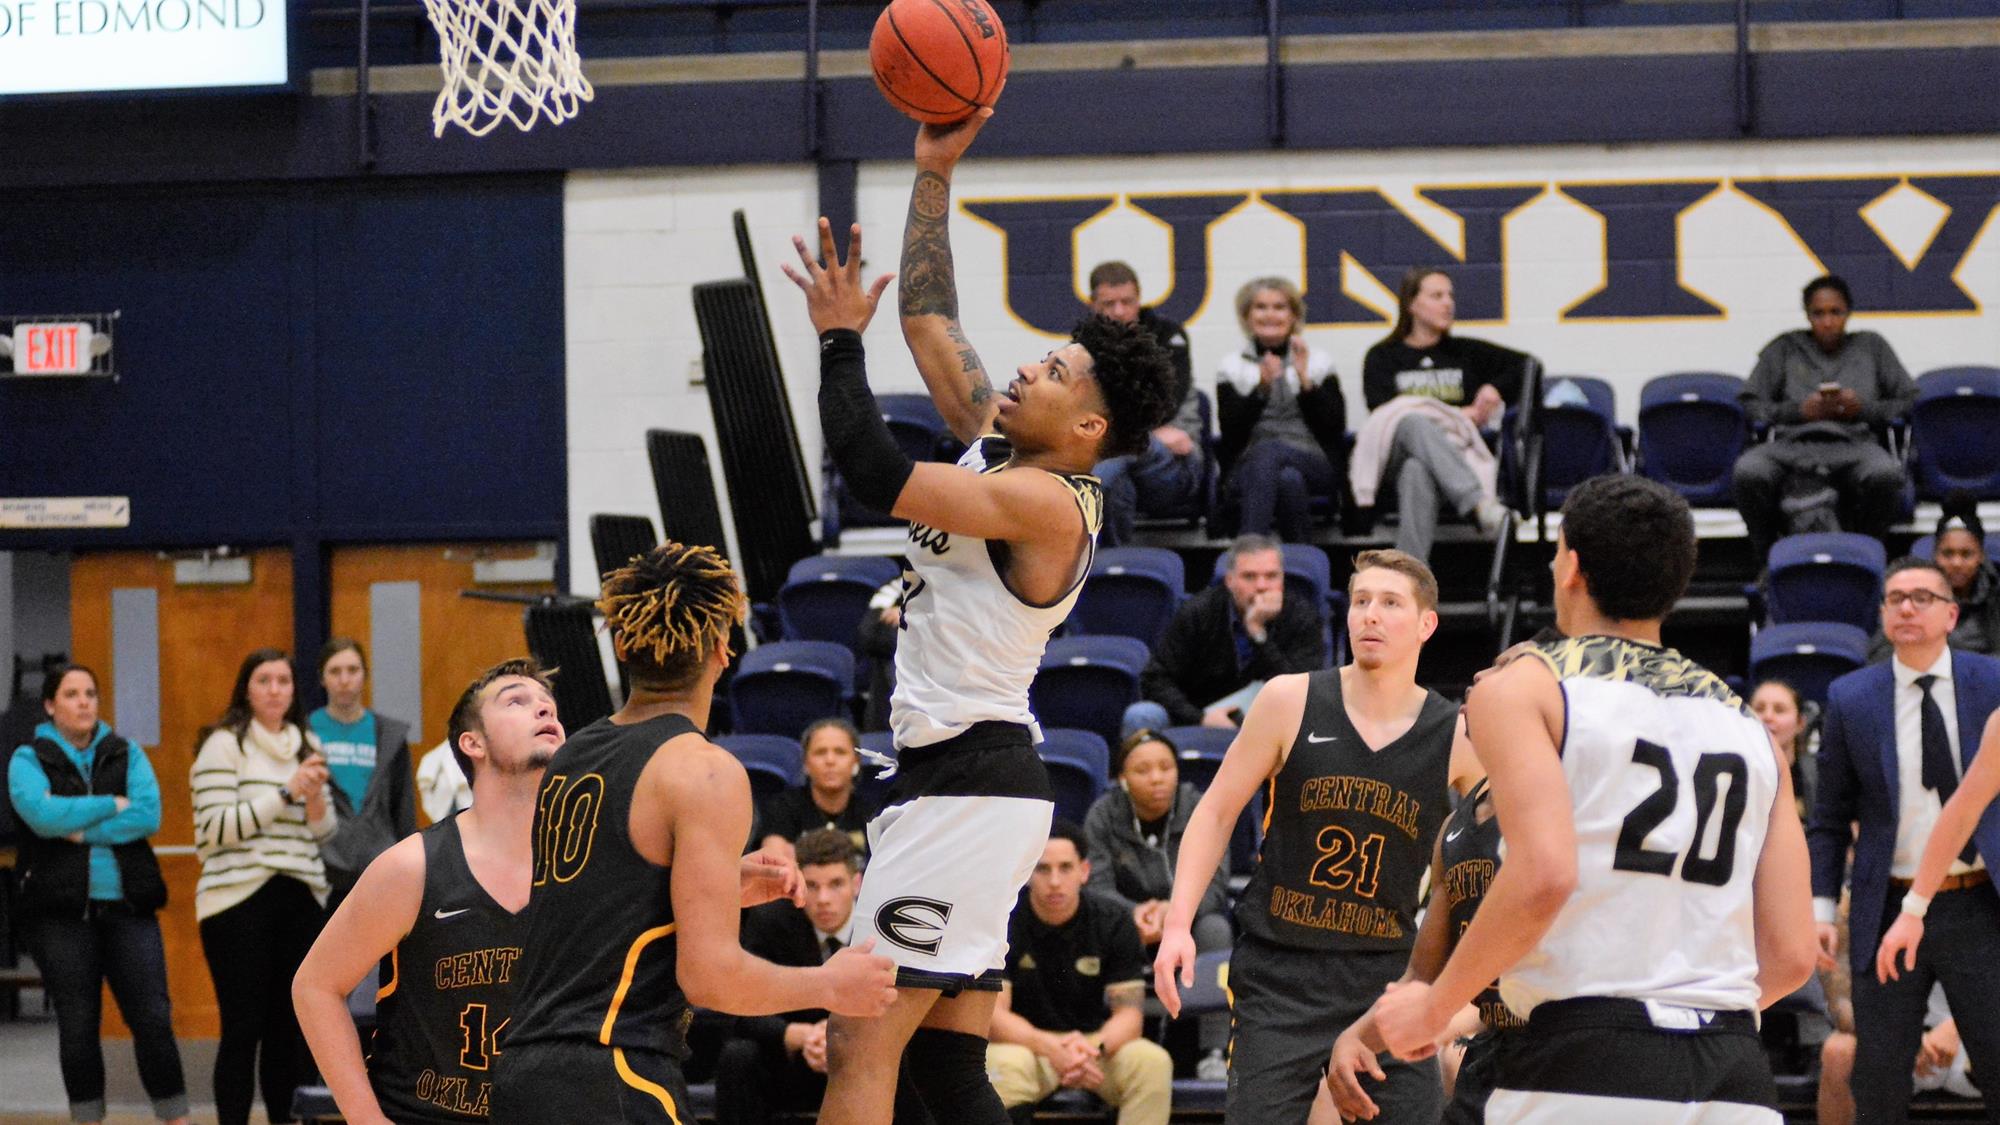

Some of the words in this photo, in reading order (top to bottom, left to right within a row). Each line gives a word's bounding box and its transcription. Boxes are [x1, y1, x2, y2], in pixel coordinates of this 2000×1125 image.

[55, 0, 265, 36] EDMOND
[957, 171, 2000, 341] UNIV
[27, 326, 78, 369] EXIT
[533, 773, 604, 886] 10
[1300, 776, 1421, 839] CENTRAL
[1612, 737, 1748, 887] 20
[1309, 825, 1385, 898] 21
[435, 947, 523, 989] CENT
